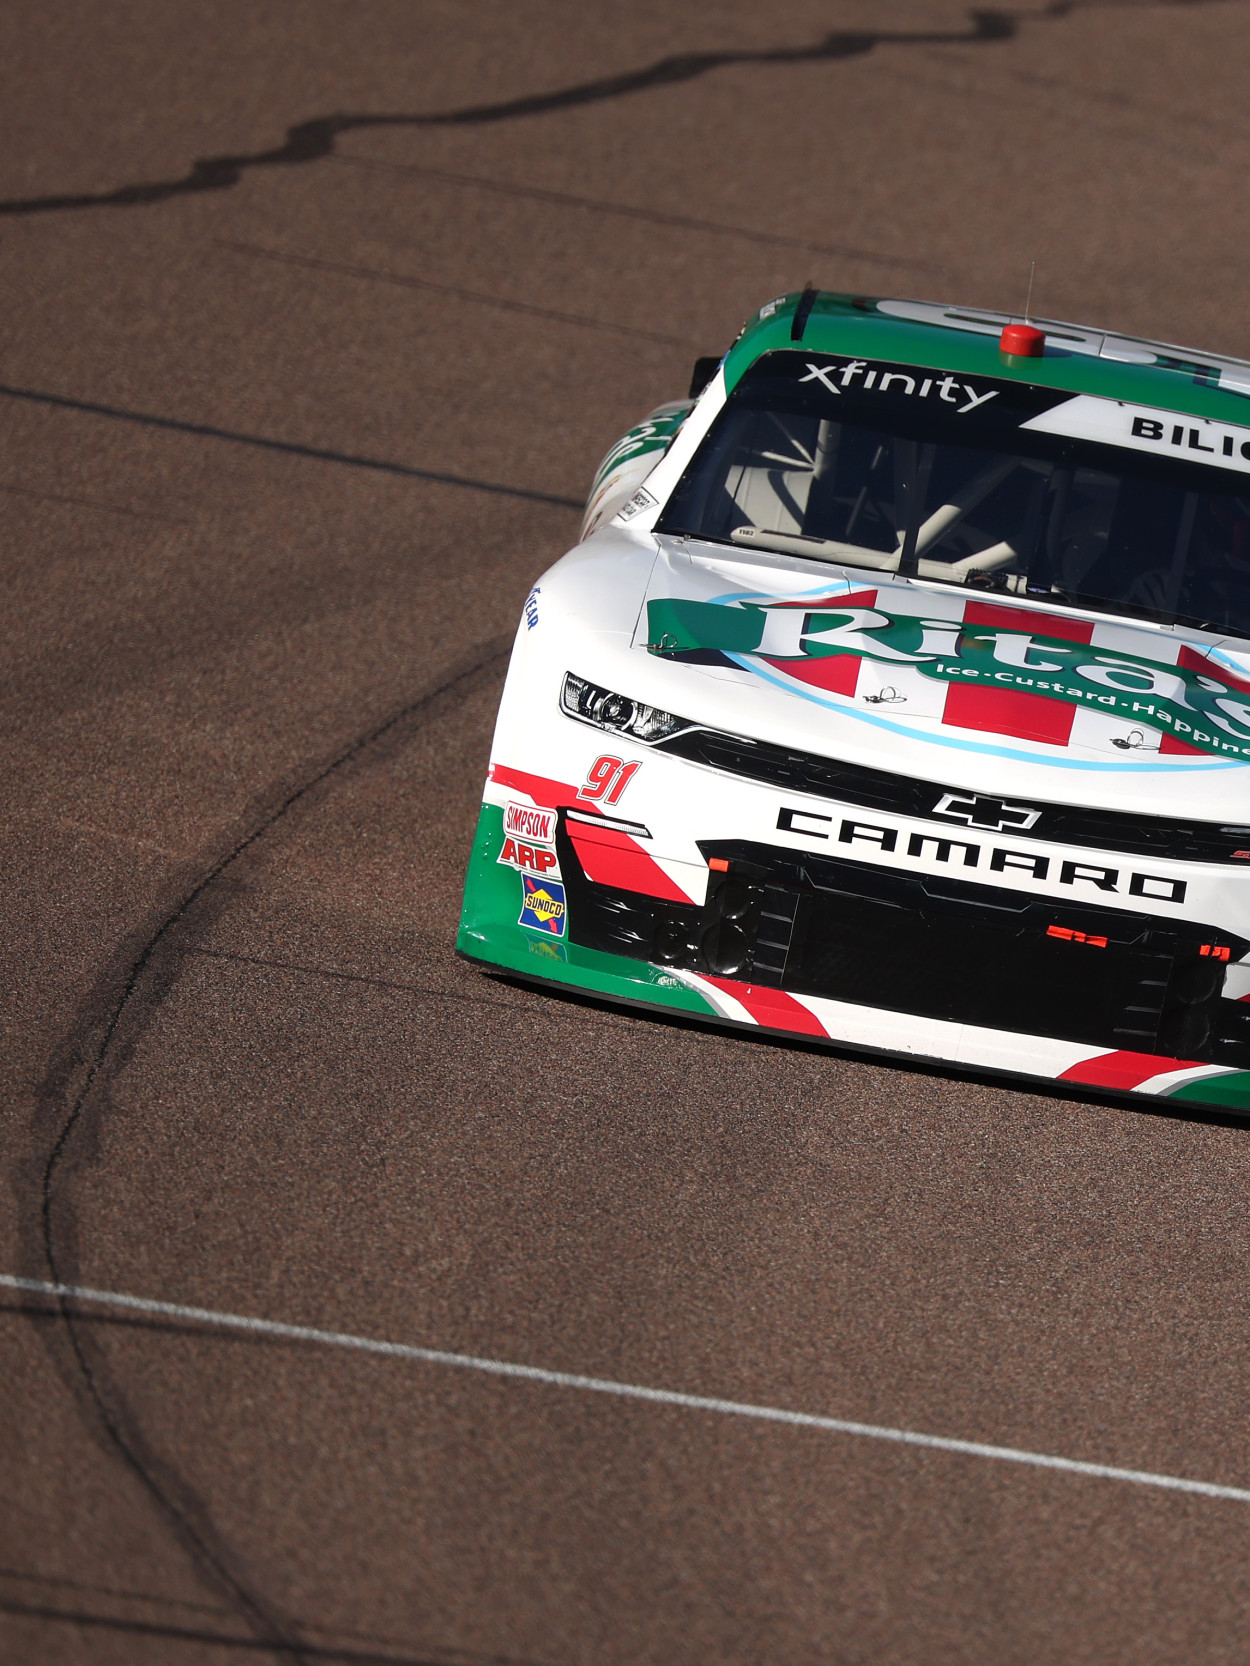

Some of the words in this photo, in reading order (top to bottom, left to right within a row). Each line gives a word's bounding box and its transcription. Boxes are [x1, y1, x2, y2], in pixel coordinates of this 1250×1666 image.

[799, 361, 1000, 413] xfinity
[577, 755, 643, 806] 91
[506, 805, 551, 839] SIMPSON
[500, 837, 557, 873] ARP
[775, 807, 1188, 905] CAMARO
[526, 895, 563, 916] SUNOCO
